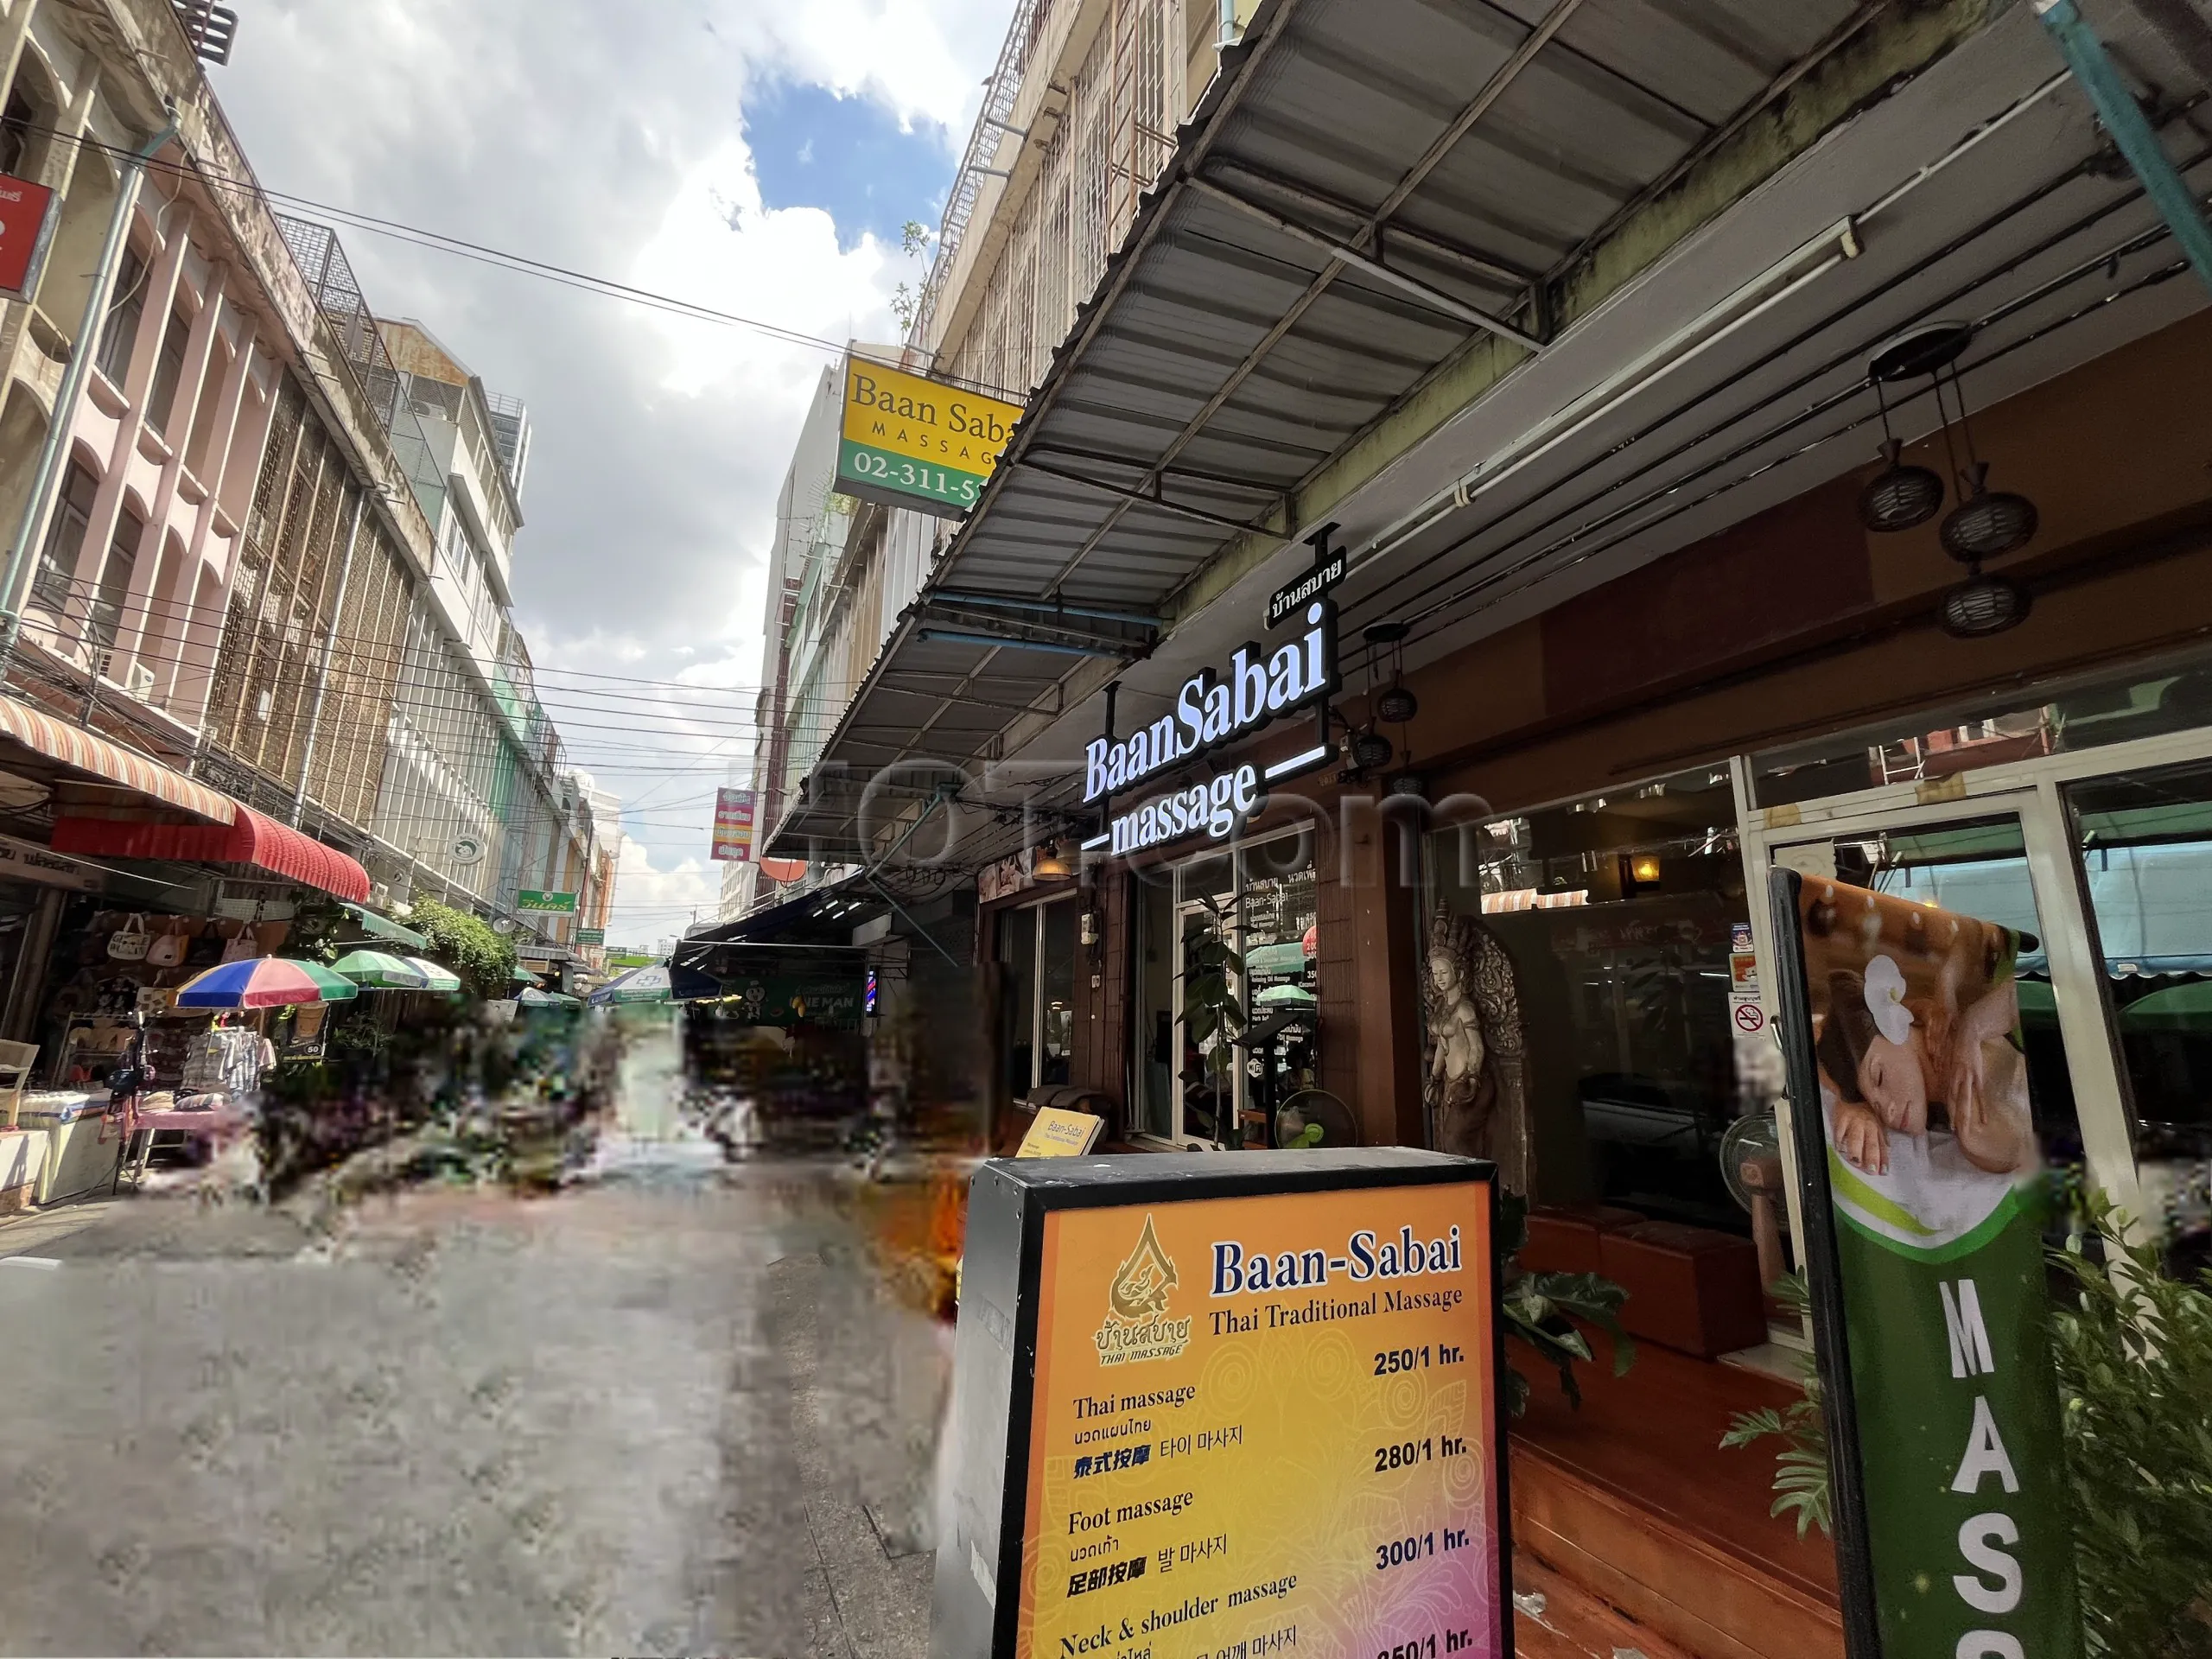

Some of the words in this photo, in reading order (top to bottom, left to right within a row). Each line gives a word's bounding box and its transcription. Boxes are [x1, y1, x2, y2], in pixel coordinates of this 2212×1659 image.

[851, 373, 938, 426] Baan
[854, 452, 980, 501] 02-311-5
[1271, 559, 1343, 619] บ้านสบาย
[1083, 602, 1326, 804] BaanSabai
[1110, 764, 1257, 857] massage
[1245, 890, 1288, 909] Baan-Sabai
[822, 996, 855, 1008] MAN
[1047, 1120, 1087, 1138] Baan-Sabai
[1211, 1225, 1461, 1296] Baan-Sabai
[1209, 1308, 1260, 1337] Thai
[1264, 1290, 1377, 1329] Traditional
[1382, 1287, 1464, 1315] Massage
[1096, 1314, 1190, 1351] บ้านสบาย
[1100, 1352, 1126, 1365] THAI
[1129, 1344, 1183, 1361] MASSAGE
[1374, 1345, 1430, 1376] 250/1
[1439, 1344, 1465, 1365] hr.
[1073, 1394, 1116, 1420] Thai
[1120, 1385, 1196, 1412] massage
[1074, 1419, 1152, 1445] นวดแผนไทย
[1160, 1434, 1192, 1459] 타이
[1197, 1424, 1243, 1452] 마사지
[1072, 1444, 1152, 1479] 泰式按摩
[1374, 1438, 1432, 1472] 280/1
[1441, 1435, 1467, 1458] hr.
[1938, 1278, 2026, 1659] MAS
[1068, 1507, 1111, 1535] Foot
[1116, 1491, 1194, 1523] massage
[1070, 1534, 1120, 1562] นวดเท้า
[1157, 1546, 1175, 1573] 발
[1180, 1533, 1228, 1564] 마사지
[1376, 1531, 1434, 1571] 300/1
[1443, 1528, 1470, 1552] hr.
[1065, 1556, 1148, 1599] 足部按摩
[1059, 1624, 1112, 1659] Neck
[1118, 1618, 1135, 1642] &
[1141, 1596, 1219, 1635] shoulder
[1227, 1574, 1297, 1609] massage
[1252, 1624, 1296, 1656] 마사지
[1446, 1628, 1473, 1654] hr.
